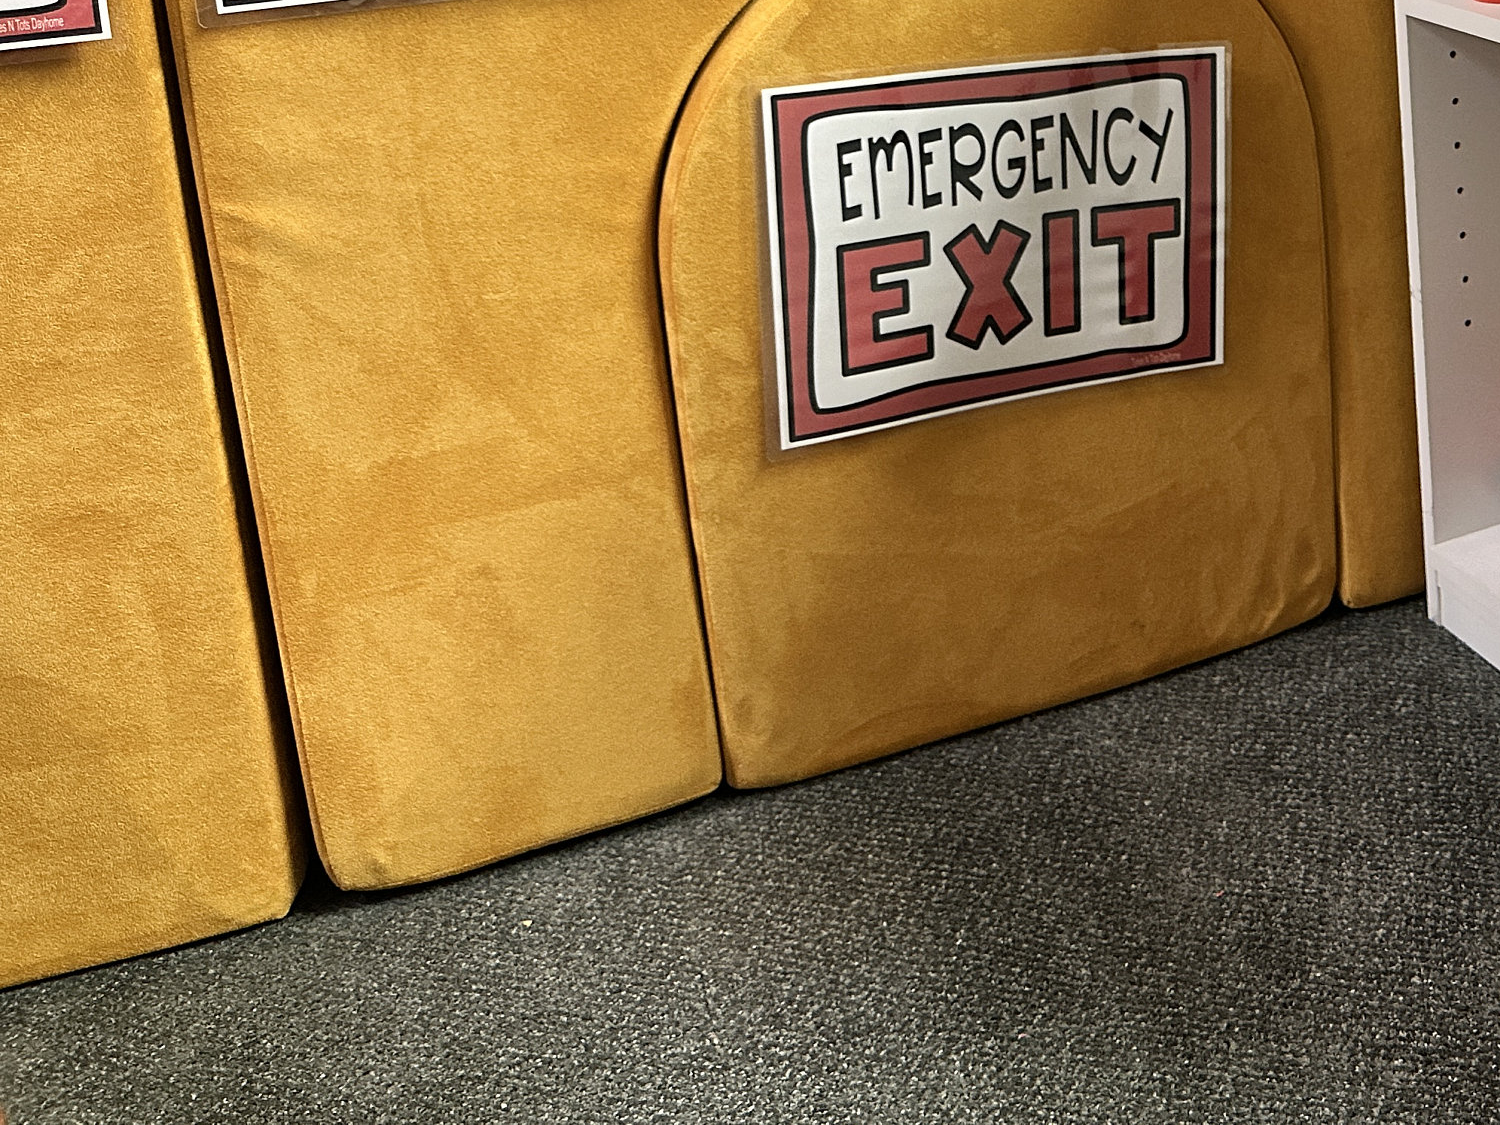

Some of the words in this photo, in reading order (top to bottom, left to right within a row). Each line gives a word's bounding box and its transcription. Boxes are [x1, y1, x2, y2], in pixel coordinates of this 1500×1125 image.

[15, 18, 31, 31] Tots
[837, 107, 1174, 222] EMERGENCY
[836, 198, 1181, 377] EXIT
